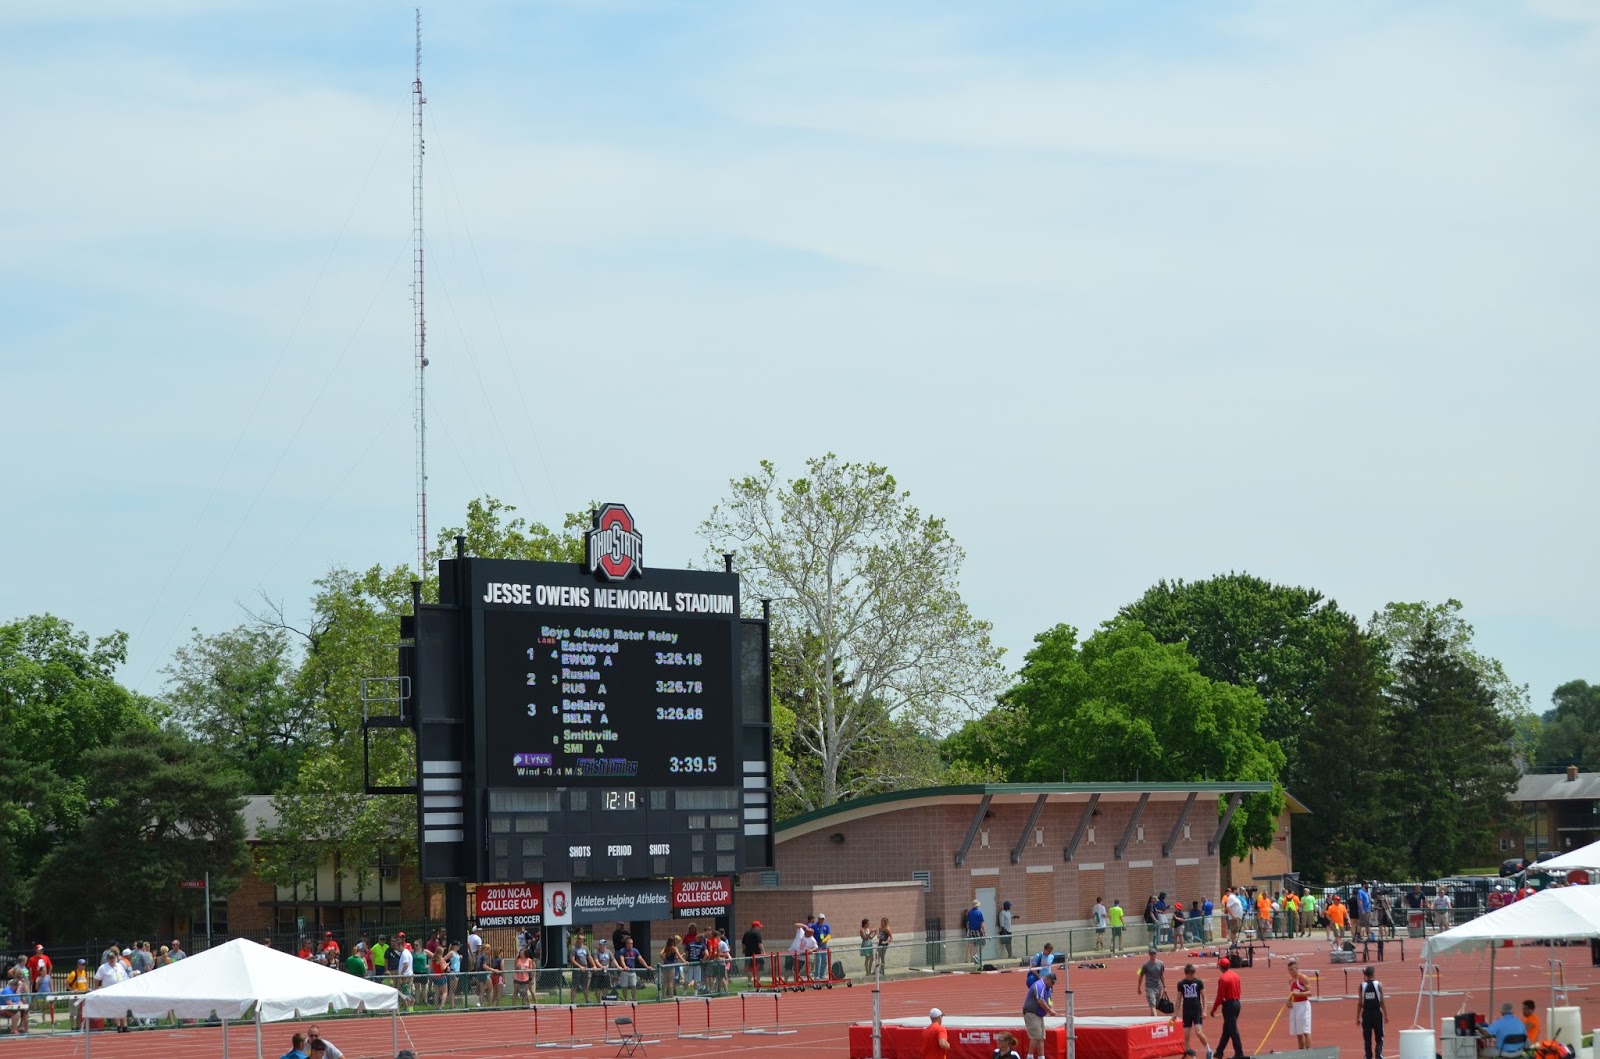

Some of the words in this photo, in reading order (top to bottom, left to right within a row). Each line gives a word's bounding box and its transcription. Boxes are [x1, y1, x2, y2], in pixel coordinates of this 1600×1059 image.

[483, 582, 531, 605] JESSE
[536, 585, 590, 607] OWENS
[594, 588, 672, 611] MEMORIAL
[675, 592, 734, 614] STADIUM
[541, 626, 570, 639] Boys
[613, 629, 644, 640] Meter
[648, 630, 678, 644] Relay
[527, 648, 534, 660] 1
[551, 650, 558, 659] 4
[561, 640, 619, 653] Eastwood
[603, 655, 613, 666] A
[655, 652, 703, 666] 3:26.18
[526, 672, 536, 686] 2
[552, 675, 558, 684] 3
[562, 668, 600, 680] Russia
[562, 683, 586, 694] RUS
[598, 683, 607, 694] A
[656, 680, 703, 693] 3:26.78
[527, 703, 537, 717] 3
[562, 699, 605, 711] Bellaire
[562, 713, 592, 724] BELR
[600, 714, 608, 724] A
[656, 707, 703, 720] 3:26.88
[553, 735, 559, 744] 8
[563, 729, 618, 741] Smithville
[563, 743, 583, 753] SMI
[595, 744, 604, 753] A
[669, 756, 717, 772] 3:39.5
[517, 768, 540, 776] Wind
[543, 767, 561, 776] -0.4
[565, 767, 583, 776] M/S
[606, 791, 636, 809] 12:19
[569, 846, 591, 858] SHOTS
[608, 845, 632, 857] PERIOD
[649, 844, 670, 855] SHOTS
[682, 881, 700, 892] 2007
[701, 880, 723, 891] NCAA
[487, 889, 506, 899] 2010
[507, 888, 532, 898] NCAA
[676, 892, 711, 903] COLLEGE
[712, 891, 729, 901] CUP
[481, 899, 520, 911] COLLEGE
[521, 899, 539, 909] CUP
[574, 895, 605, 907] Athletes
[606, 893, 635, 908] Helping
[681, 908, 700, 917] MEN'S
[701, 906, 725, 916] SOCCER
[479, 916, 513, 926] WOMEN'S
[514, 915, 541, 925] SOCCER
